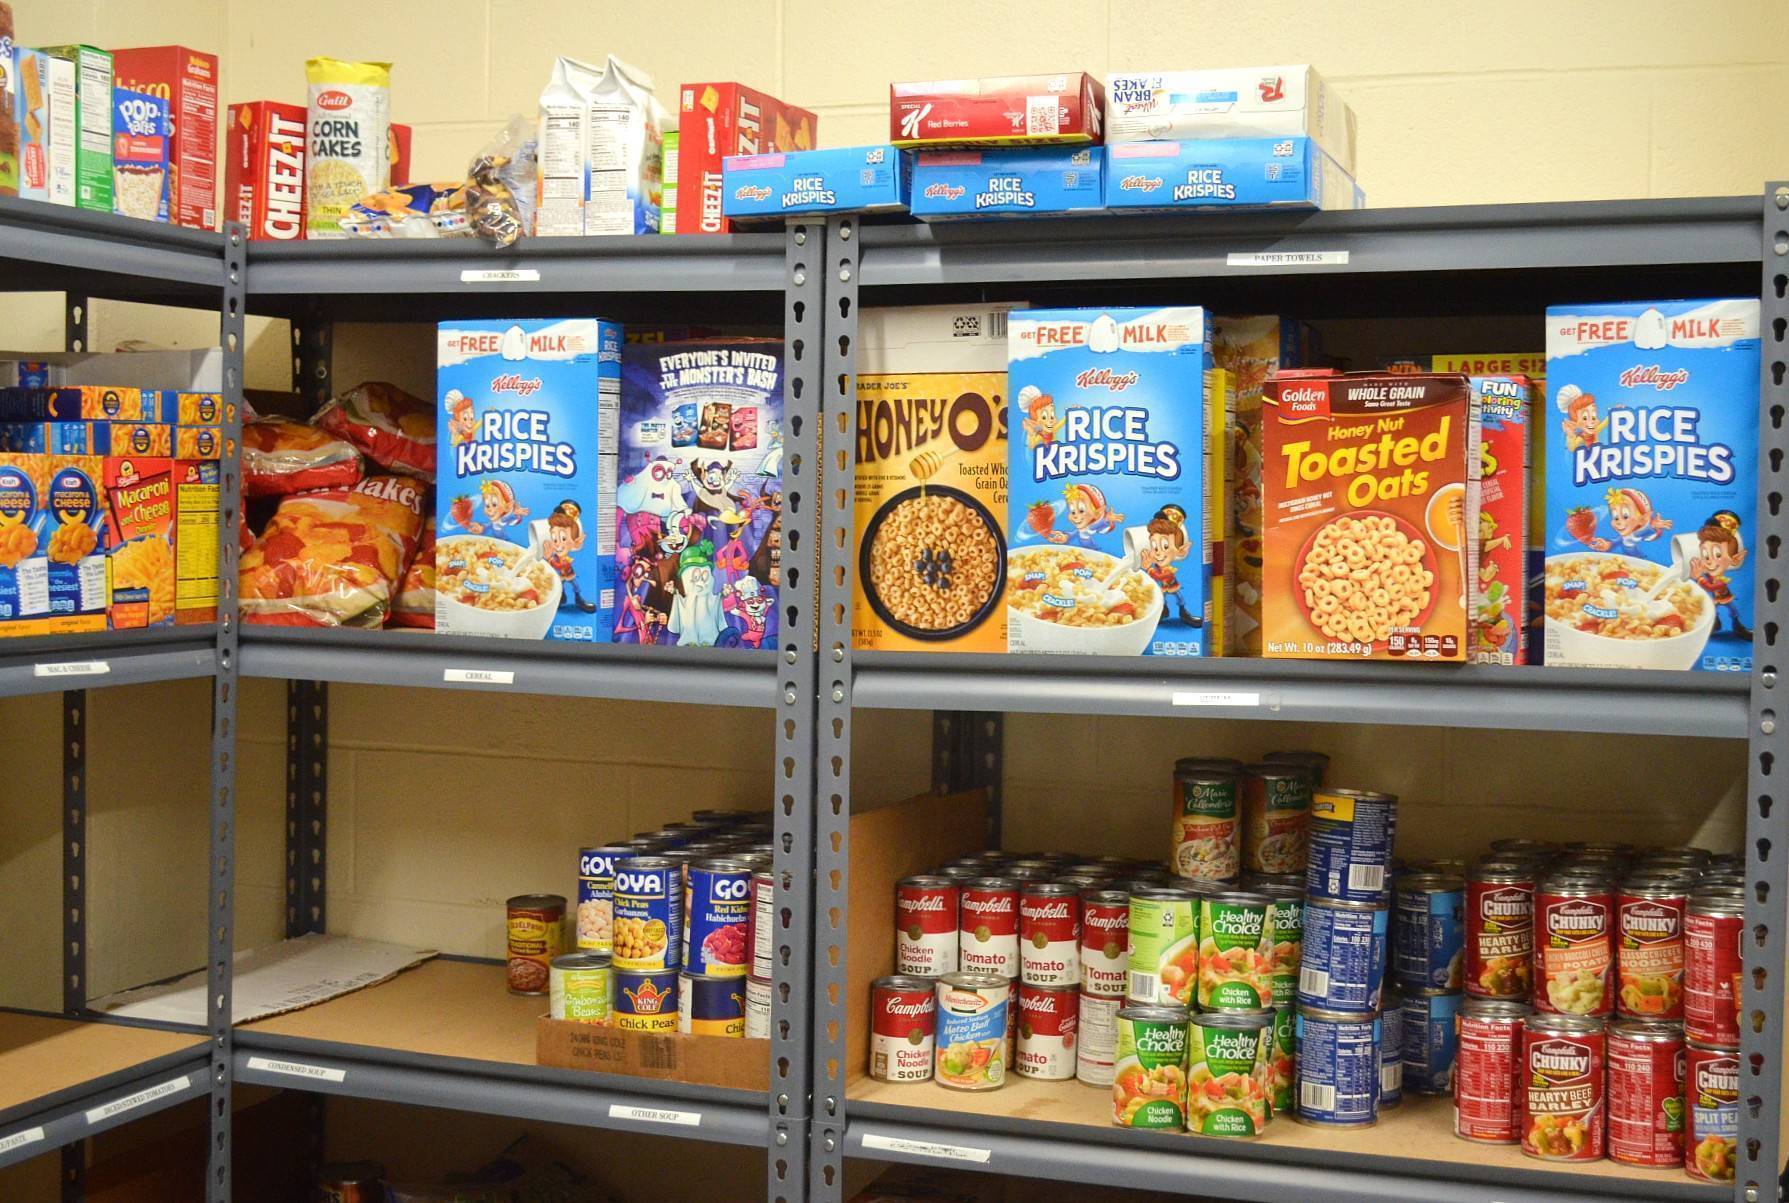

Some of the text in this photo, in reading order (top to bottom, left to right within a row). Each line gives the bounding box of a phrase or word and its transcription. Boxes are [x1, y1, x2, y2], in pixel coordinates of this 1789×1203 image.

[1113, 90, 1151, 103] BRAN
[901, 103, 969, 139] K Red Berries
[312, 121, 359, 138] CORN
[312, 140, 362, 158] CAKES
[1121, 176, 1163, 192] Kellogg's
[1187, 169, 1222, 184] RICE
[793, 177, 824, 193] RICE
[924, 184, 966, 200] Kellogg's
[989, 178, 1022, 193] RICE
[1173, 184, 1236, 201] KRISPIES
[781, 190, 836, 208] KRISPIES
[975, 191, 1035, 209] KRISPIES
[322, 207, 342, 215] THIN
[1254, 254, 1323, 263] PAPER TOWELS
[482, 272, 520, 280] CRACKERS
[1020, 325, 1167, 344] GET FREE MILK
[1560, 319, 1721, 341] GET FREE MILK
[448, 335, 566, 353] GET FREE MILK
[659, 350, 778, 373] EVERYONE'S INVITED
[1447, 358, 1547, 374] LARGE SIZ
[680, 366, 778, 390] MONSTER'S BASH
[1077, 368, 1137, 390] Kellogg's
[1621, 366, 1687, 389] Kellogg's
[491, 376, 542, 395] Kellogg's
[856, 382, 908, 390] RADER JOE'S
[1481, 380, 1517, 397] FUN
[1282, 388, 1326, 402] Golden
[1348, 386, 1426, 401] WHOLE GRAIN
[1291, 402, 1317, 412] Foods
[1383, 400, 1396, 408] Great
[1481, 396, 1521, 410] oloring
[1482, 404, 1514, 418] tivity
[483, 412, 549, 442] RICE
[856, 398, 949, 464] HONEY
[1067, 409, 1147, 442] RICE
[1327, 417, 1405, 441] Honey Nut
[1611, 409, 1697, 443] RICE
[457, 442, 576, 477] KRISPIES
[1281, 416, 1451, 489] Toasted
[959, 463, 989, 476] Toasted
[1034, 443, 1179, 481] KRISPIES
[1575, 445, 1735, 483] KRISPIES
[975, 477, 998, 490] Grain
[1347, 468, 1430, 508] Oats
[117, 478, 169, 508] Macaroni
[134, 500, 170, 522] Cheese
[1390, 636, 1404, 646] 150
[1267, 643, 1283, 653] Net
[1302, 643, 1314, 653] 10
[1315, 645, 1325, 653] oz
[1326, 643, 1361, 655] (283.49
[1362, 643, 1372, 656] g)
[69, 664, 92, 672] CHEESE
[465, 672, 493, 681] CEREAL
[580, 856, 615, 875] GOY
[631, 900, 649, 909] Peas
[714, 905, 729, 914] Red
[1484, 900, 1532, 916] CHUNKY
[1219, 909, 1263, 924] Healthy
[1550, 913, 1604, 930] CHUNKY
[1622, 914, 1676, 933] CHUNKY
[1213, 920, 1261, 935] Choice
[900, 943, 934, 954] Chicken
[1479, 935, 1520, 948] HEARTY
[1480, 943, 1531, 955] BARLE
[900, 952, 933, 963] Noodle
[963, 949, 1006, 965] Tomato
[1023, 957, 1065, 971] Tomato
[1563, 956, 1609, 970] POTATO
[1621, 957, 1683, 968] NOODLE
[901, 963, 932, 974] SOUP
[966, 964, 999, 973] SOUP
[1089, 966, 1127, 981] Tomat
[1026, 971, 1058, 982] SOUP
[1222, 987, 1249, 996] Chicken
[637, 998, 657, 1006] KING
[1219, 995, 1252, 1004] with Rice
[573, 1005, 601, 1017] Beans
[620, 1017, 675, 1029] Chick Peas
[944, 1019, 991, 1035] Matzo Ball
[1462, 1022, 1489, 1031] Nutrition
[949, 1031, 981, 1043] Chicken
[1144, 1025, 1186, 1042] Healthy
[1213, 1033, 1258, 1049] Healthy
[1136, 1038, 1184, 1052] Choice
[1206, 1044, 1256, 1060] Choice
[896, 1049, 931, 1060] Chicken
[1532, 1051, 1589, 1072] CHUNKY
[267, 1062, 326, 1077] CONDENSED SOUP
[897, 1059, 929, 1068] Noodle
[897, 1069, 929, 1079] SOUP
[1698, 1070, 1738, 1090] CHUN
[146, 1083, 175, 1099] TOMATOES
[1528, 1087, 1593, 1103] HEARTY BEEF
[1147, 1106, 1174, 1115] Chicken
[1529, 1100, 1592, 1111] BARLEY
[631, 1109, 679, 1121] OTHER SOUP
[1148, 1114, 1173, 1123] Noodle
[1216, 1114, 1244, 1123] Chicken
[1695, 1112, 1720, 1124] SPLIT
[1213, 1122, 1246, 1132] with Rice
